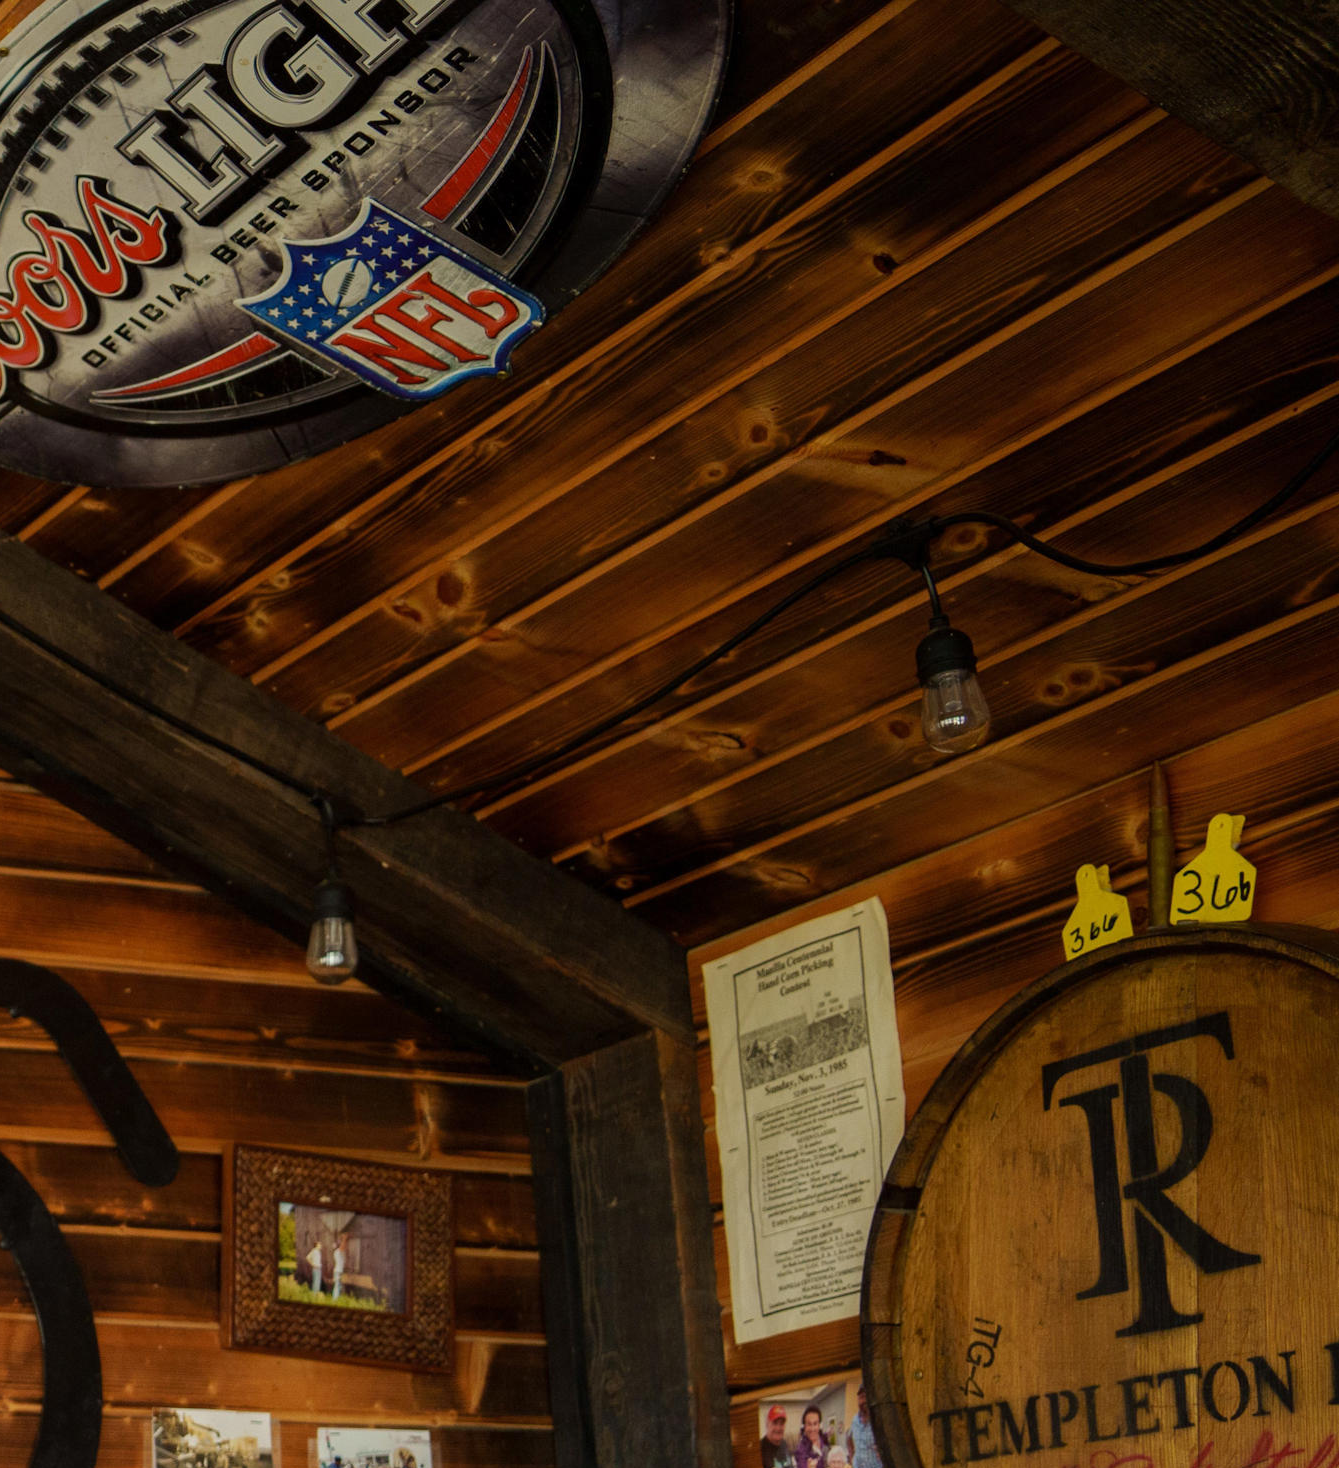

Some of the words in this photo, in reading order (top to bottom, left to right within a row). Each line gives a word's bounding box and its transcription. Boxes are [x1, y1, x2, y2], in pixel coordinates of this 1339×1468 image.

[82, 267, 215, 371] OFFICIAL
[209, 194, 302, 269] BEER
[298, 43, 482, 194] SPONSOR
[330, 271, 524, 386] NFL
[928, 1350, 1298, 1467] TEMPLETON
